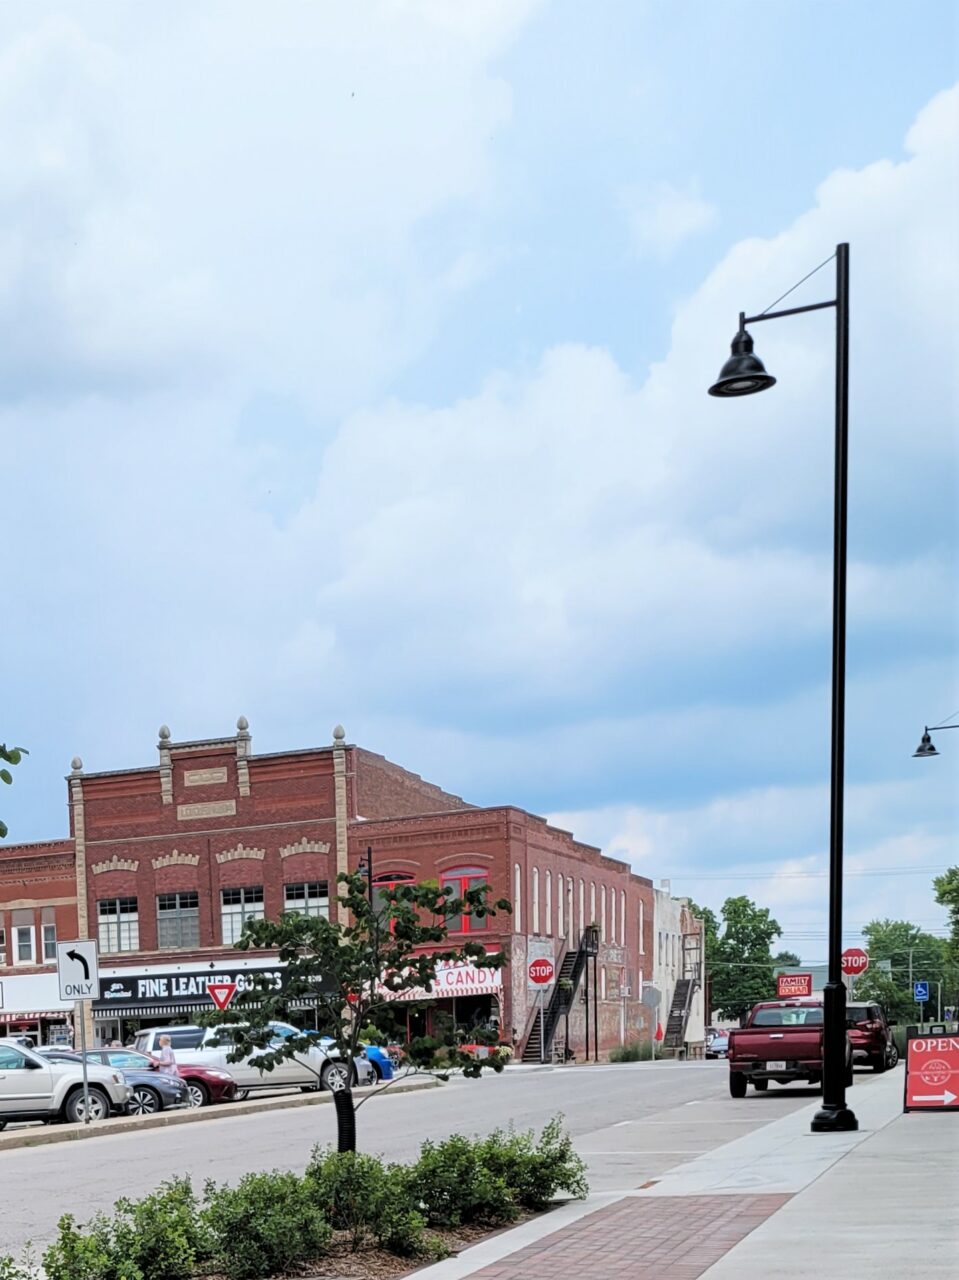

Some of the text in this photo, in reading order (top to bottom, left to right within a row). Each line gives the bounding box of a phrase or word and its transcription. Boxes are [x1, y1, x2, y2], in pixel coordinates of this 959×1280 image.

[841, 956, 867, 967] STOP
[530, 965, 553, 977] STOP
[445, 969, 497, 986] CANDY
[780, 977, 808, 986] FAMILY
[65, 983, 93, 996] ONLY
[138, 978, 168, 998] FINE
[235, 971, 283, 992] GOS
[780, 986, 807, 994] DOLLAR
[912, 1038, 959, 1052] OPEN
